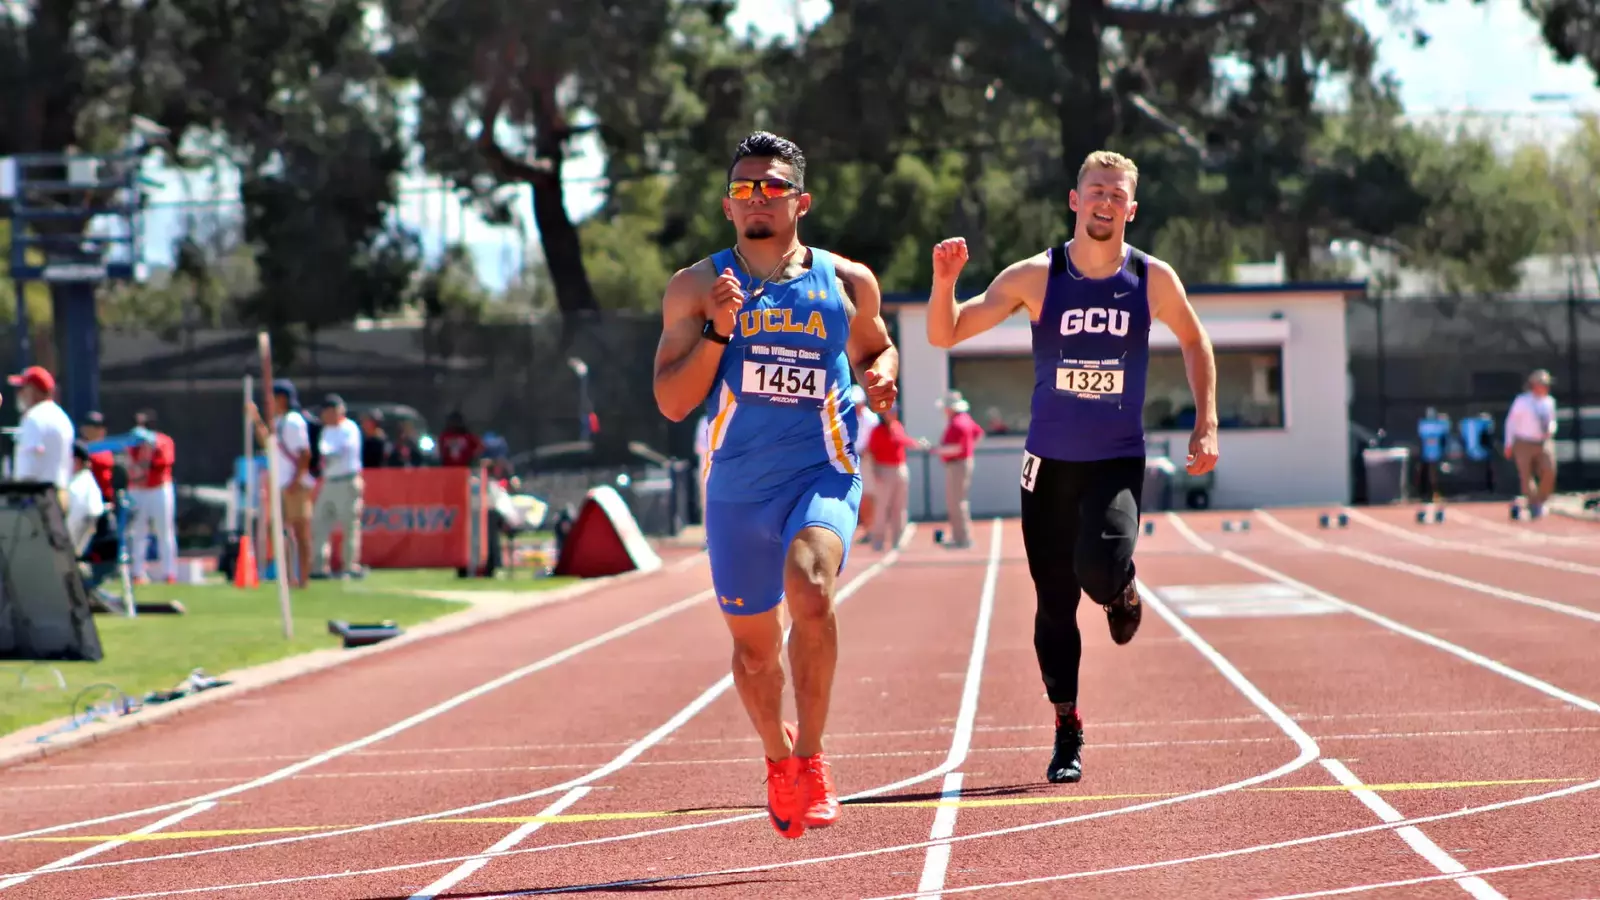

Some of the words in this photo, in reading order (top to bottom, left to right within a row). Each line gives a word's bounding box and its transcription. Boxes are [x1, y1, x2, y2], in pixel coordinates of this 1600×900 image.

[740, 308, 827, 340] UCLA
[1060, 307, 1130, 337] GCU
[751, 345, 769, 355] Willie
[771, 346, 797, 357] Williams
[798, 349, 820, 360] Classic
[755, 365, 816, 395] 1454
[1066, 370, 1115, 392] 1323
[1023, 456, 1035, 487] 4
